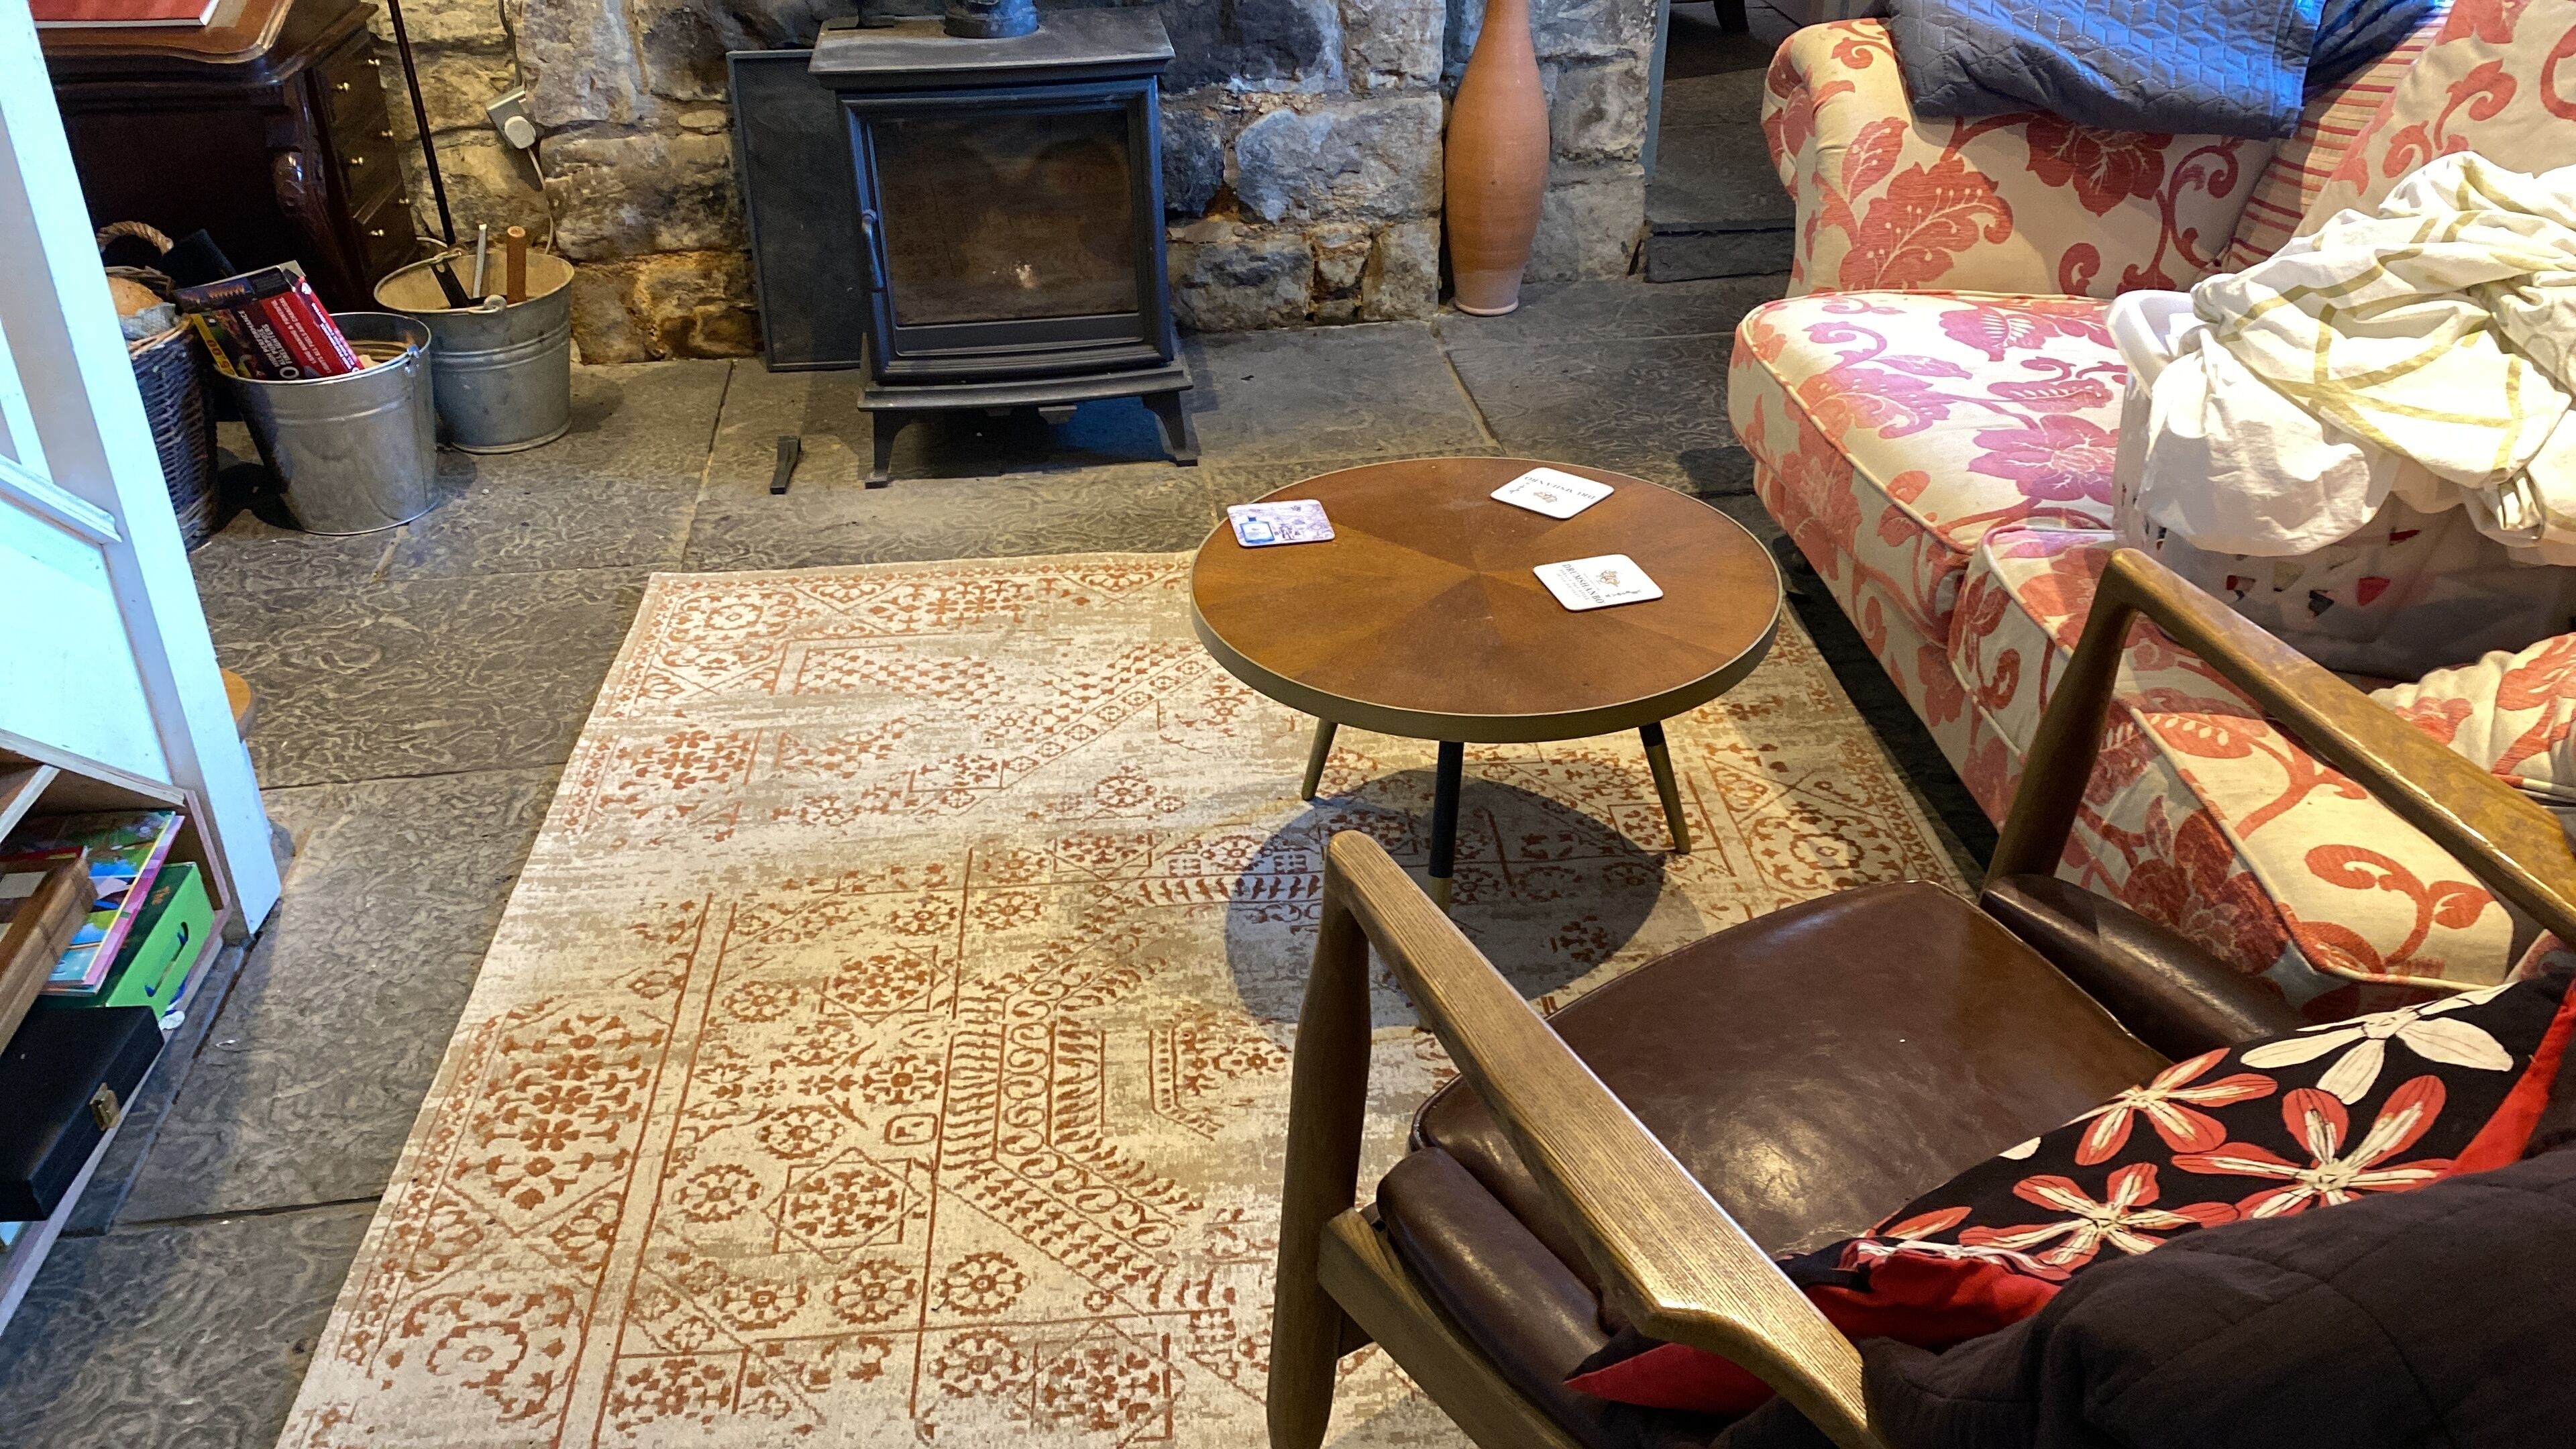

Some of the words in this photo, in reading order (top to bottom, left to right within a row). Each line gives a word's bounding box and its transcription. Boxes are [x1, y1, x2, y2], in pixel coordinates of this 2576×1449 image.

[237, 309, 270, 352] PERFORMANCE
[256, 327, 278, 354] PURPOSE
[261, 323, 292, 364] FIRELIGHTERS
